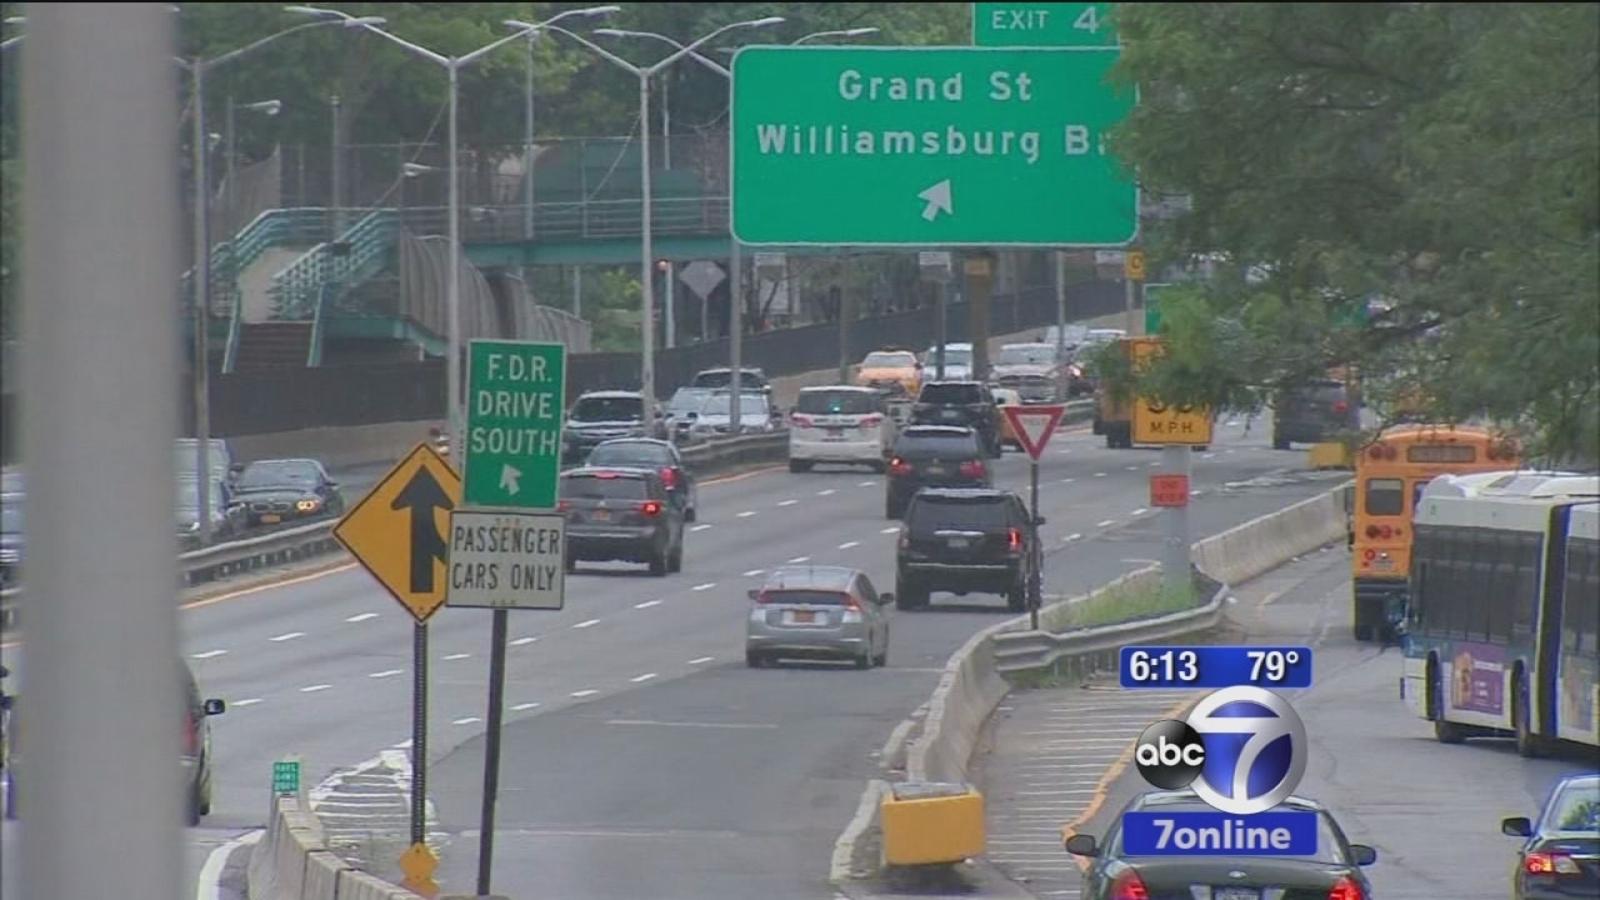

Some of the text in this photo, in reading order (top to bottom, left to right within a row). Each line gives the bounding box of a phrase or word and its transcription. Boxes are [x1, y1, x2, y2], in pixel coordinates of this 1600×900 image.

[992, 5, 1100, 34] EXIT 4
[839, 70, 1032, 101] Grand St
[757, 125, 1040, 164] Williamsburg
[488, 354, 552, 382] F.D.R.
[477, 390, 553, 418] DRIVE
[471, 427, 557, 456] SOUTH
[454, 526, 560, 555] PASSENGER
[452, 563, 557, 591] CARS ONLY
